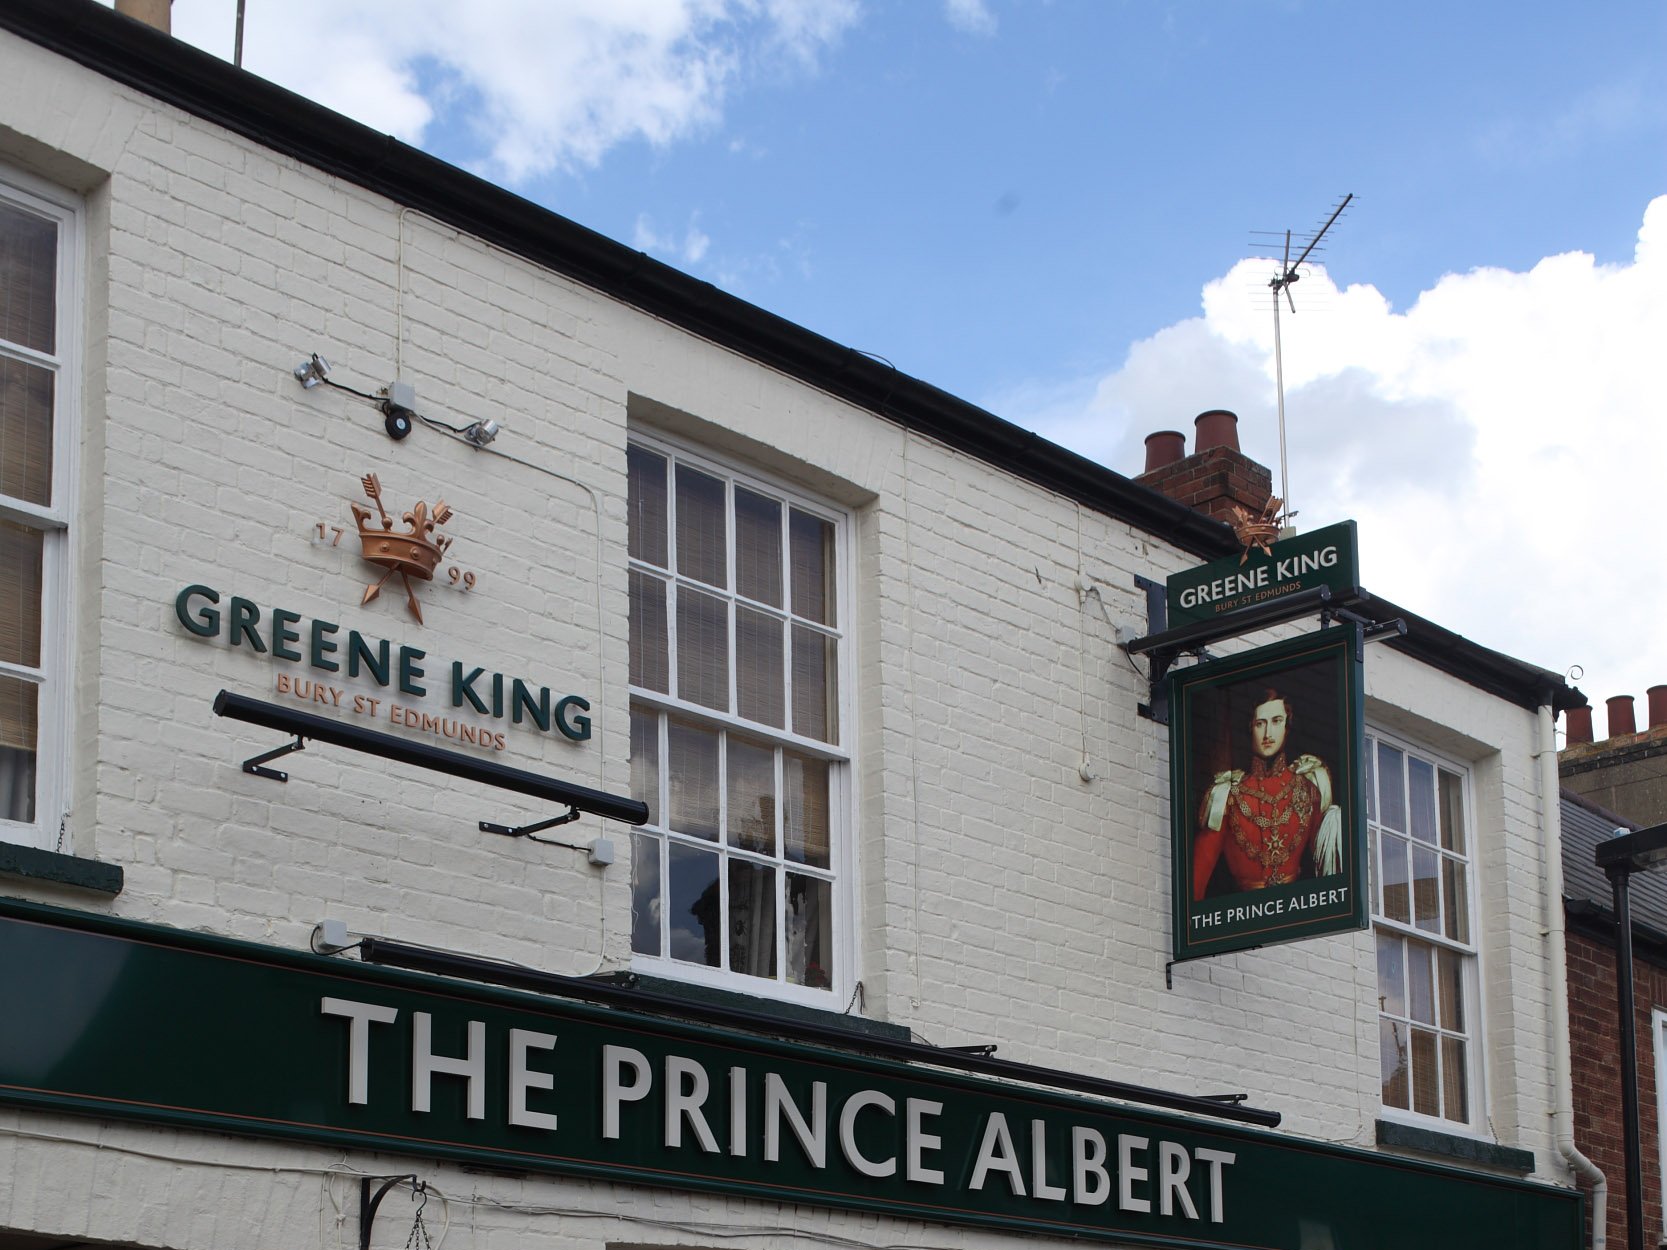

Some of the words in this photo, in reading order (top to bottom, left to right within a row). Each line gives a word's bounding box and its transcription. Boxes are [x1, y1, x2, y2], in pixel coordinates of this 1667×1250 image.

[316, 522, 344, 547] 17
[448, 566, 476, 592] 99
[1180, 565, 1269, 609] GREENE
[1276, 546, 1338, 582] KING
[1215, 599, 1238, 613] BURY
[1241, 595, 1251, 605] ST
[1255, 581, 1302, 602] EDMUNDS
[175, 584, 427, 698] GREENE
[452, 660, 592, 742] KING
[277, 673, 345, 708] BURY
[354, 694, 383, 718] ST
[390, 704, 507, 751] EDMUNDS
[1192, 911, 1222, 929] THE
[1227, 899, 1284, 923] PRINCE
[1288, 887, 1348, 911] ALBERT
[321, 996, 558, 1131] THE
[602, 1044, 945, 1185] PRINCE
[968, 1111, 1236, 1224] ALBERT
